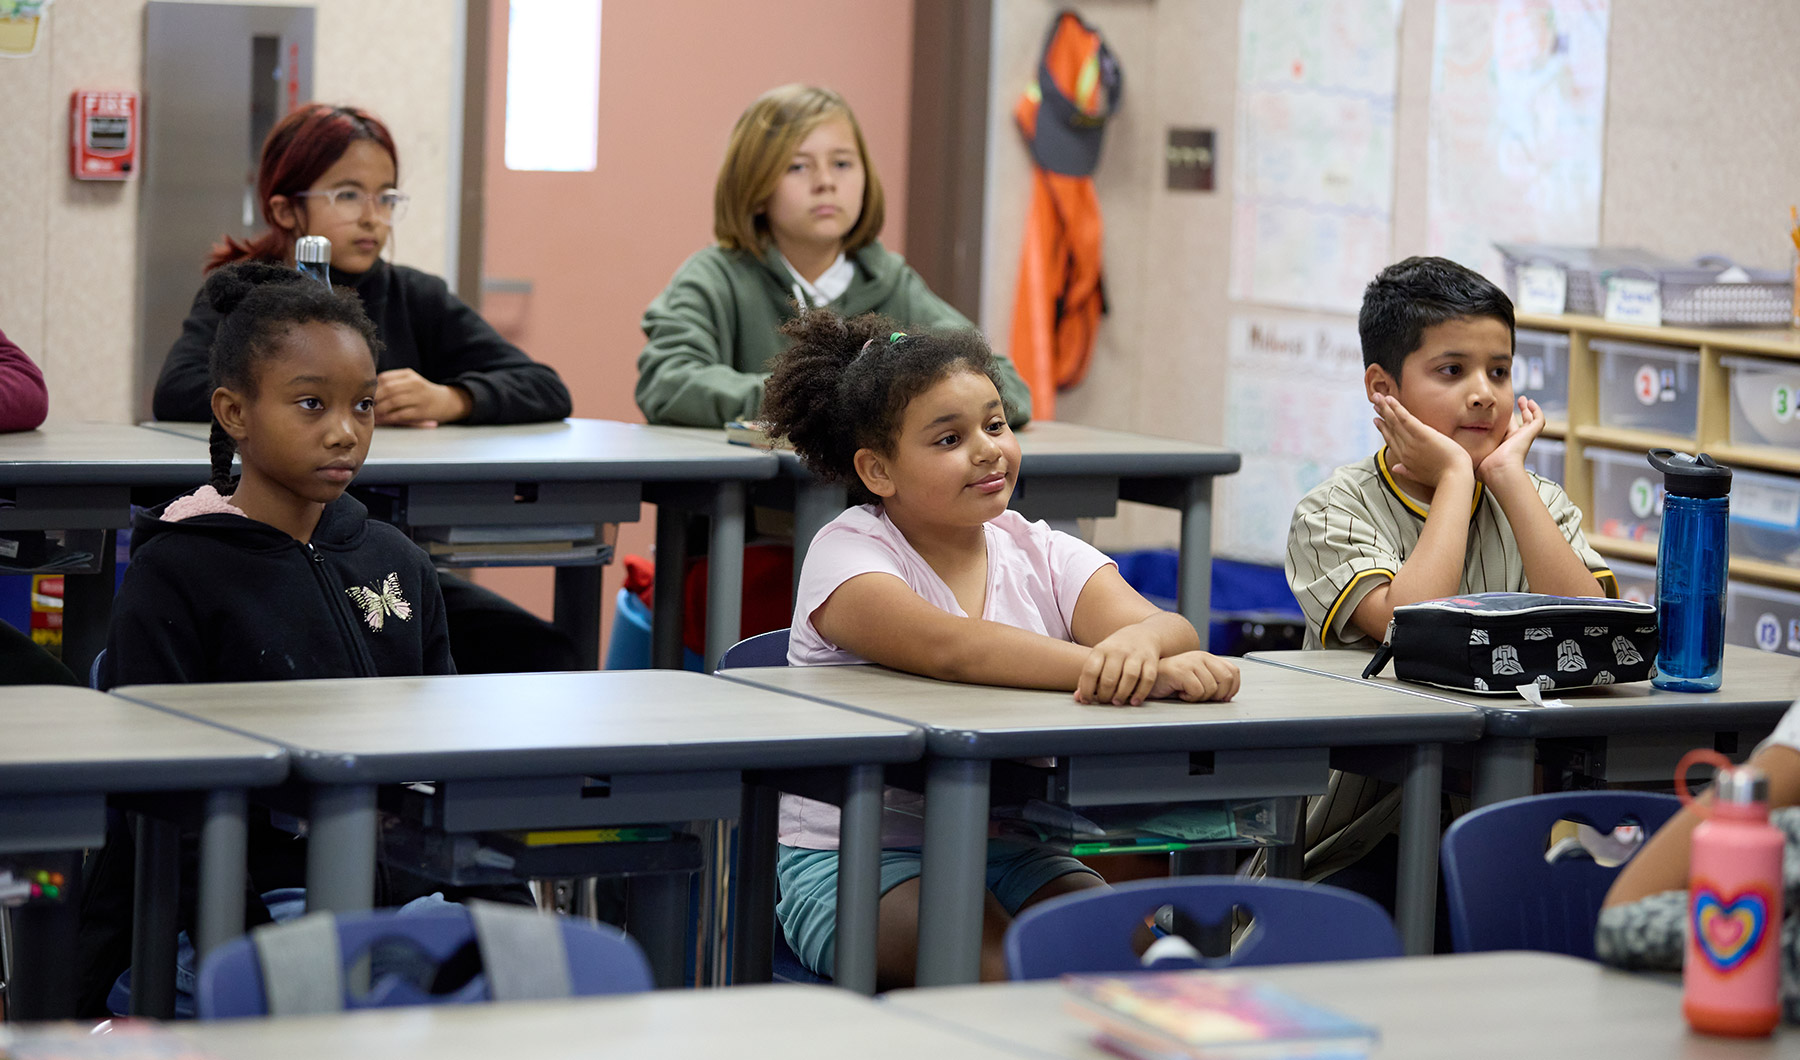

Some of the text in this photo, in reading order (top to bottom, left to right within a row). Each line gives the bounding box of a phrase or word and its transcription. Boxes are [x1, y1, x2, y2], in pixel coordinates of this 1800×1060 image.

[85, 95, 132, 116] FIRE
[1640, 373, 1652, 398] 2
[1777, 388, 1788, 415] 3
[1636, 485, 1648, 509] 7
